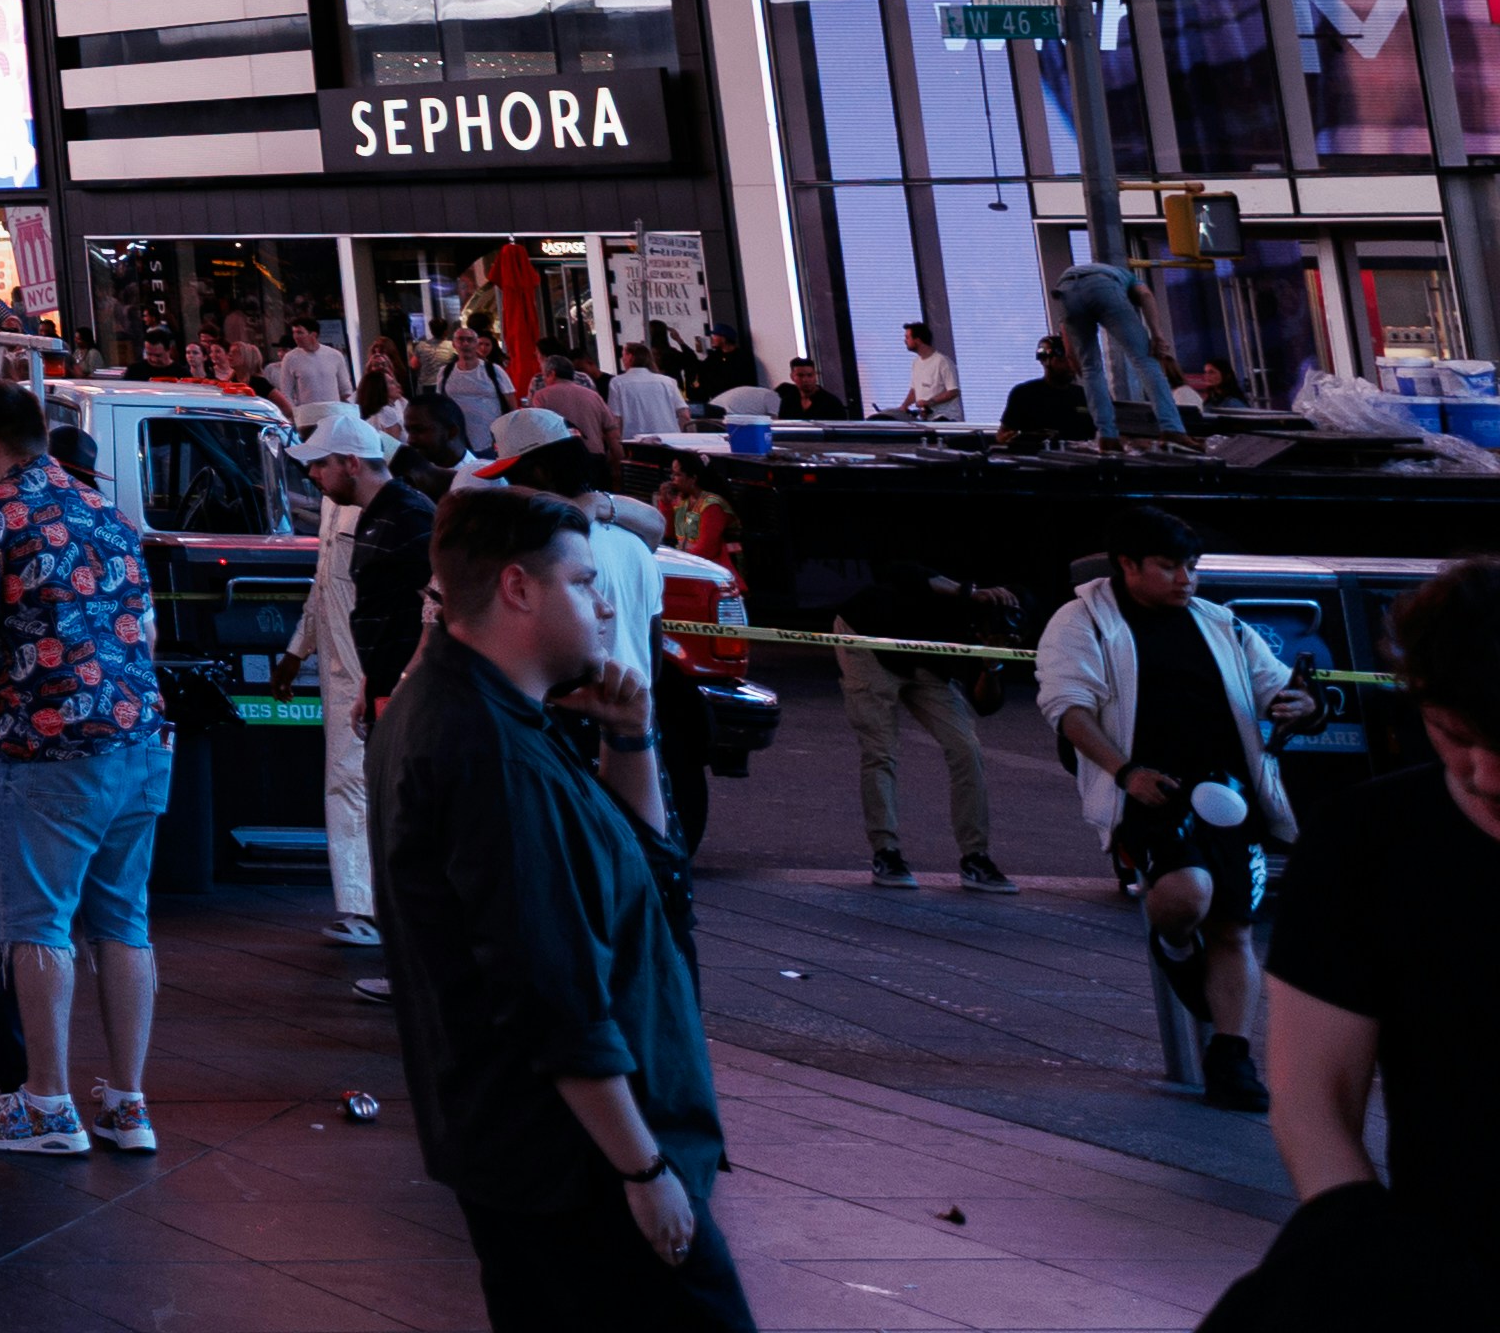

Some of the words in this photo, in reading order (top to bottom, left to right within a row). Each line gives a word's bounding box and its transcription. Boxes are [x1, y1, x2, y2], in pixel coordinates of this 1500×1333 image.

[969, 11, 990, 33] W
[1003, 9, 1030, 35] 46
[350, 87, 629, 157] SEPHORA
[26, 289, 56, 308] NYC
